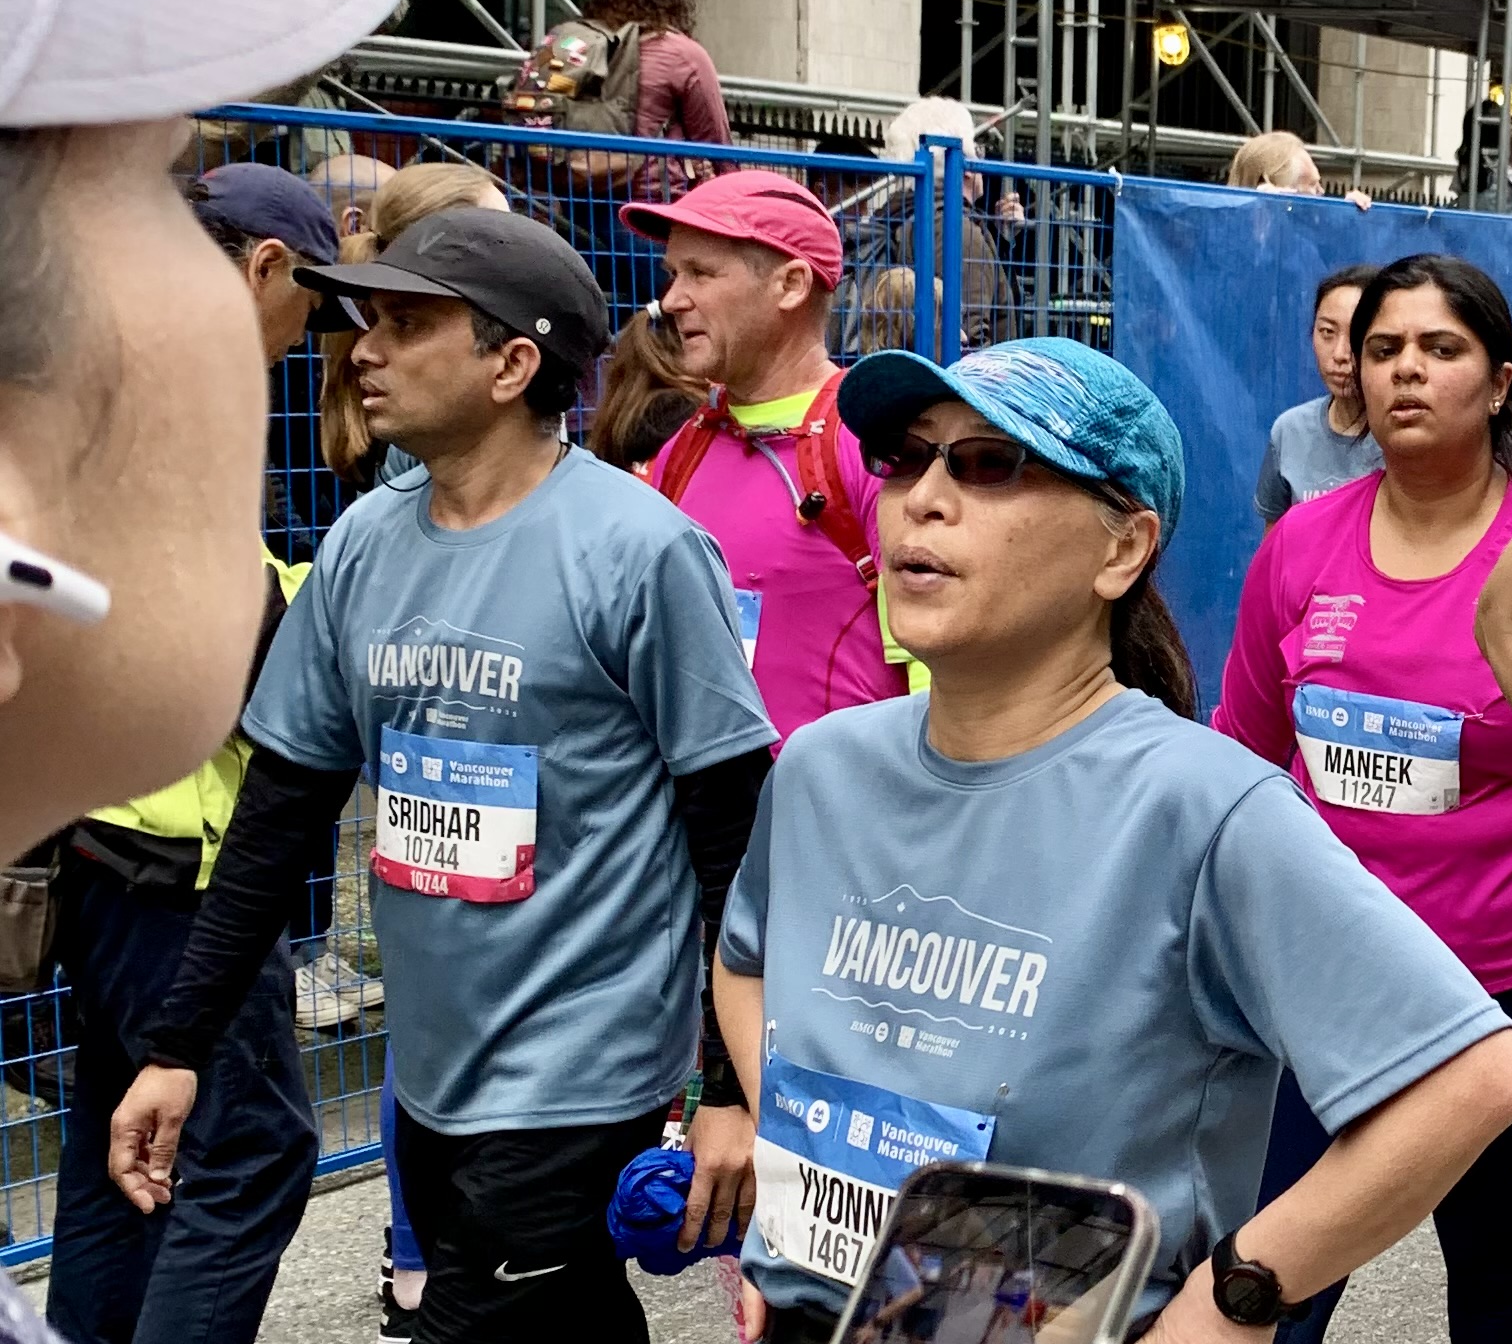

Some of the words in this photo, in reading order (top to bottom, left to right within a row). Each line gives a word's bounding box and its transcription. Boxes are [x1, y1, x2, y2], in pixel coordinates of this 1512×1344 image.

[1305, 705, 1330, 720] BMO
[1388, 725, 1438, 744] Marathon
[449, 760, 515, 777] Vancouver
[1324, 744, 1414, 786] MANEEK
[449, 772, 510, 789] Marathon
[1340, 778, 1397, 809] 11247
[388, 794, 481, 842] SRIDHAR
[404, 834, 460, 871] 10744
[410, 869, 449, 895] 10744
[820, 914, 1048, 1018] VANCOUVER
[850, 1020, 875, 1036] BMO
[918, 1029, 961, 1049] Vancouver
[914, 1040, 954, 1058] Marathon
[774, 1092, 805, 1118] BMO
[881, 1120, 960, 1157] Vancouver
